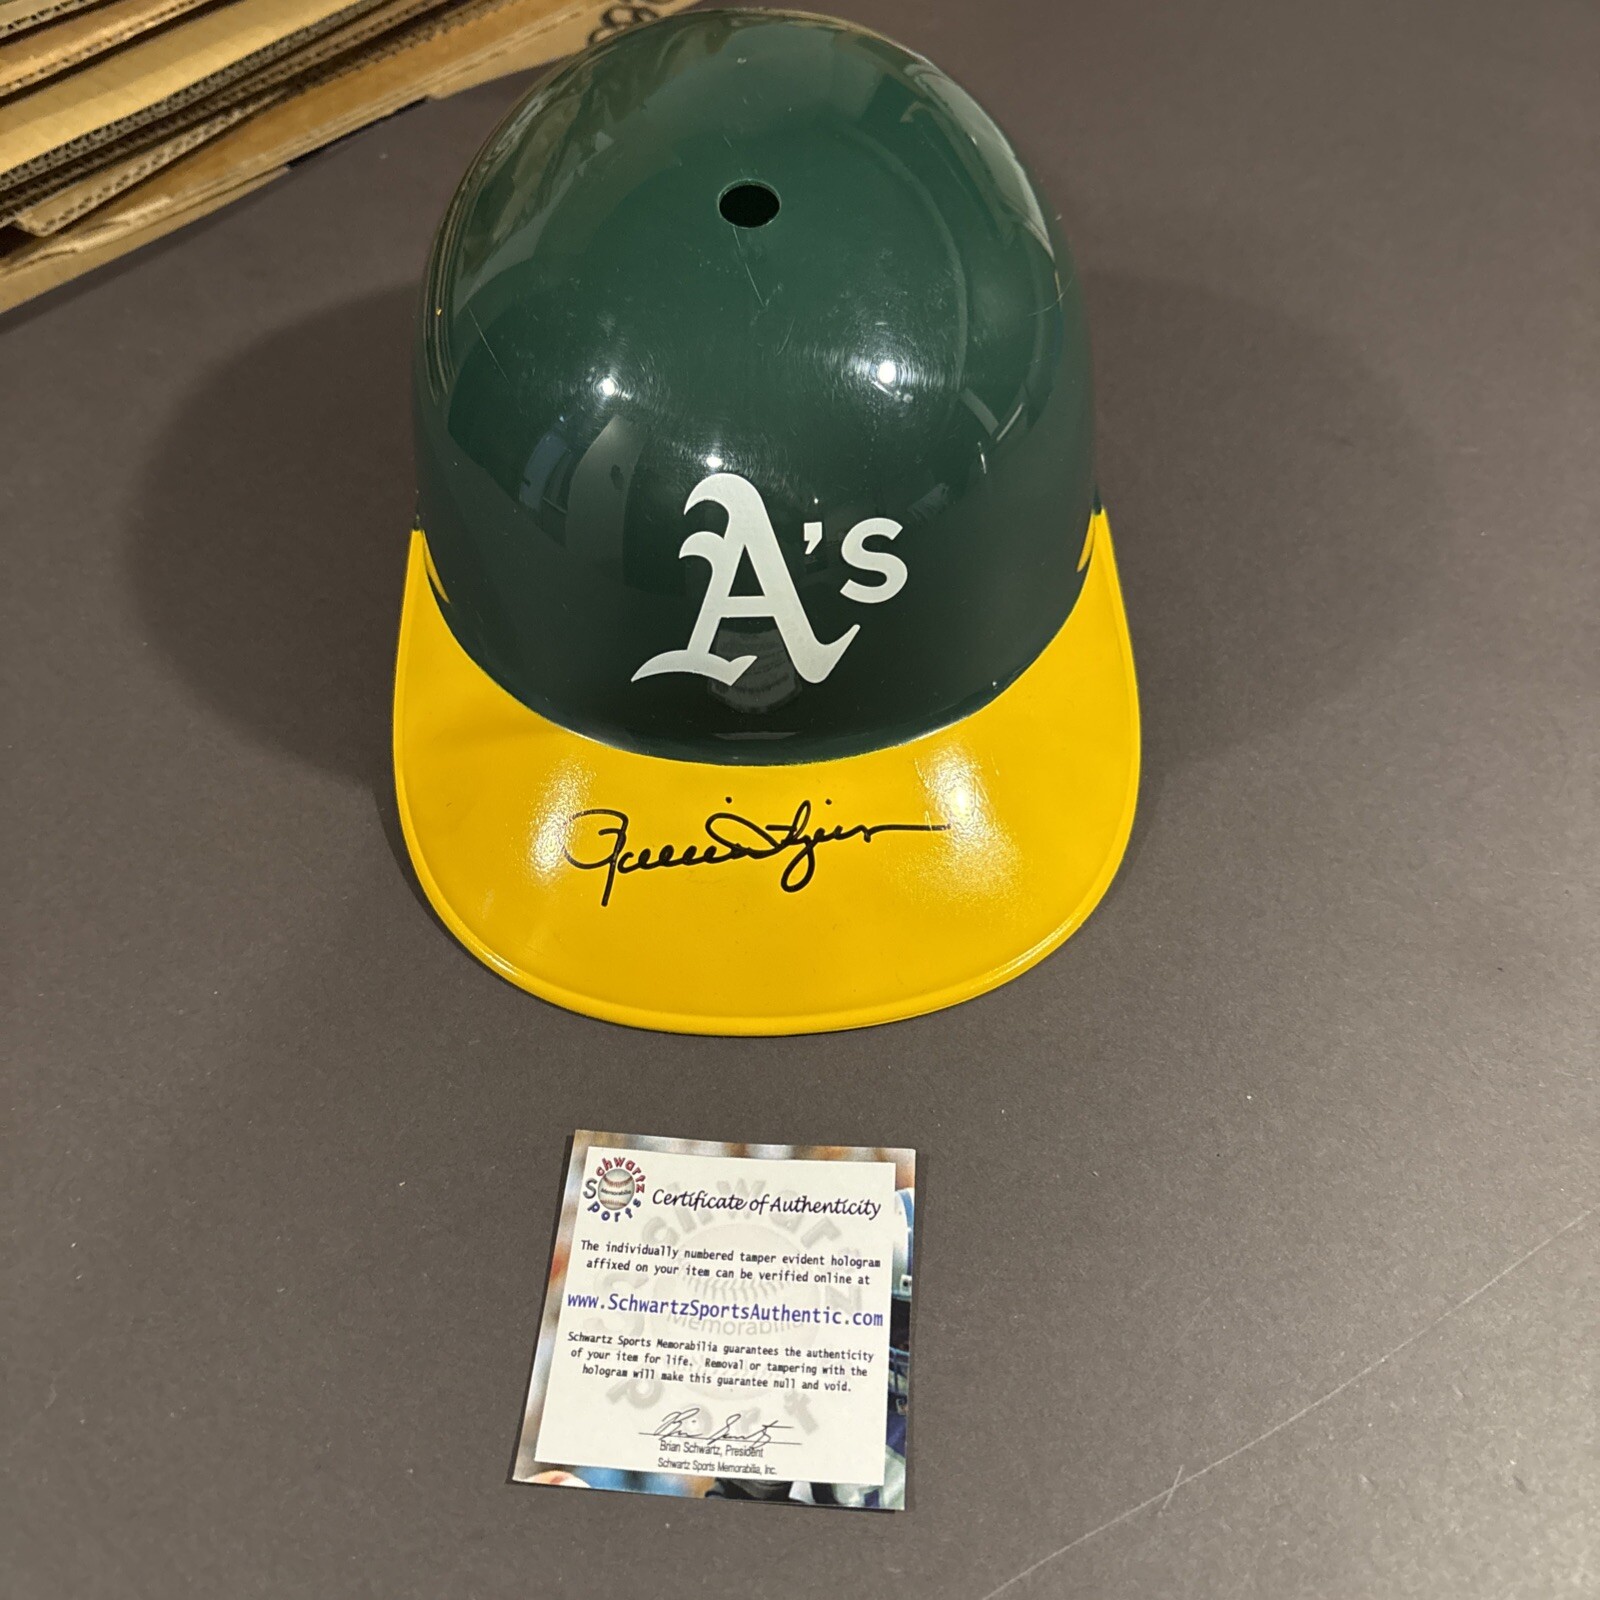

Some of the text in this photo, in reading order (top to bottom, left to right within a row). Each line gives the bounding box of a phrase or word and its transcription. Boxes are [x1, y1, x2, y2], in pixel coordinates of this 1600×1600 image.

[631, 473, 908, 686] A's
[652, 1189, 881, 1221] Certificate of Authenticity
[581, 1239, 881, 1270] The individually numbered tamper evident hologram
[586, 1258, 871, 1286] affixed on your item can be verified online at
[567, 1293, 884, 1327] www.SchwartzSportsAuthentic.com
[568, 1331, 874, 1364] Schwartz Sports Memorabilia guarantees the authenticity
[570, 1347, 868, 1377] of your item for life. Removal or tampering with the
[582, 1363, 852, 1393] hologram will make this guarantee null and void.
[659, 1439, 764, 1458] Brian Schwartz, President
[657, 1457, 778, 1475] Schwartz Sports Memorabilia, Inc.
